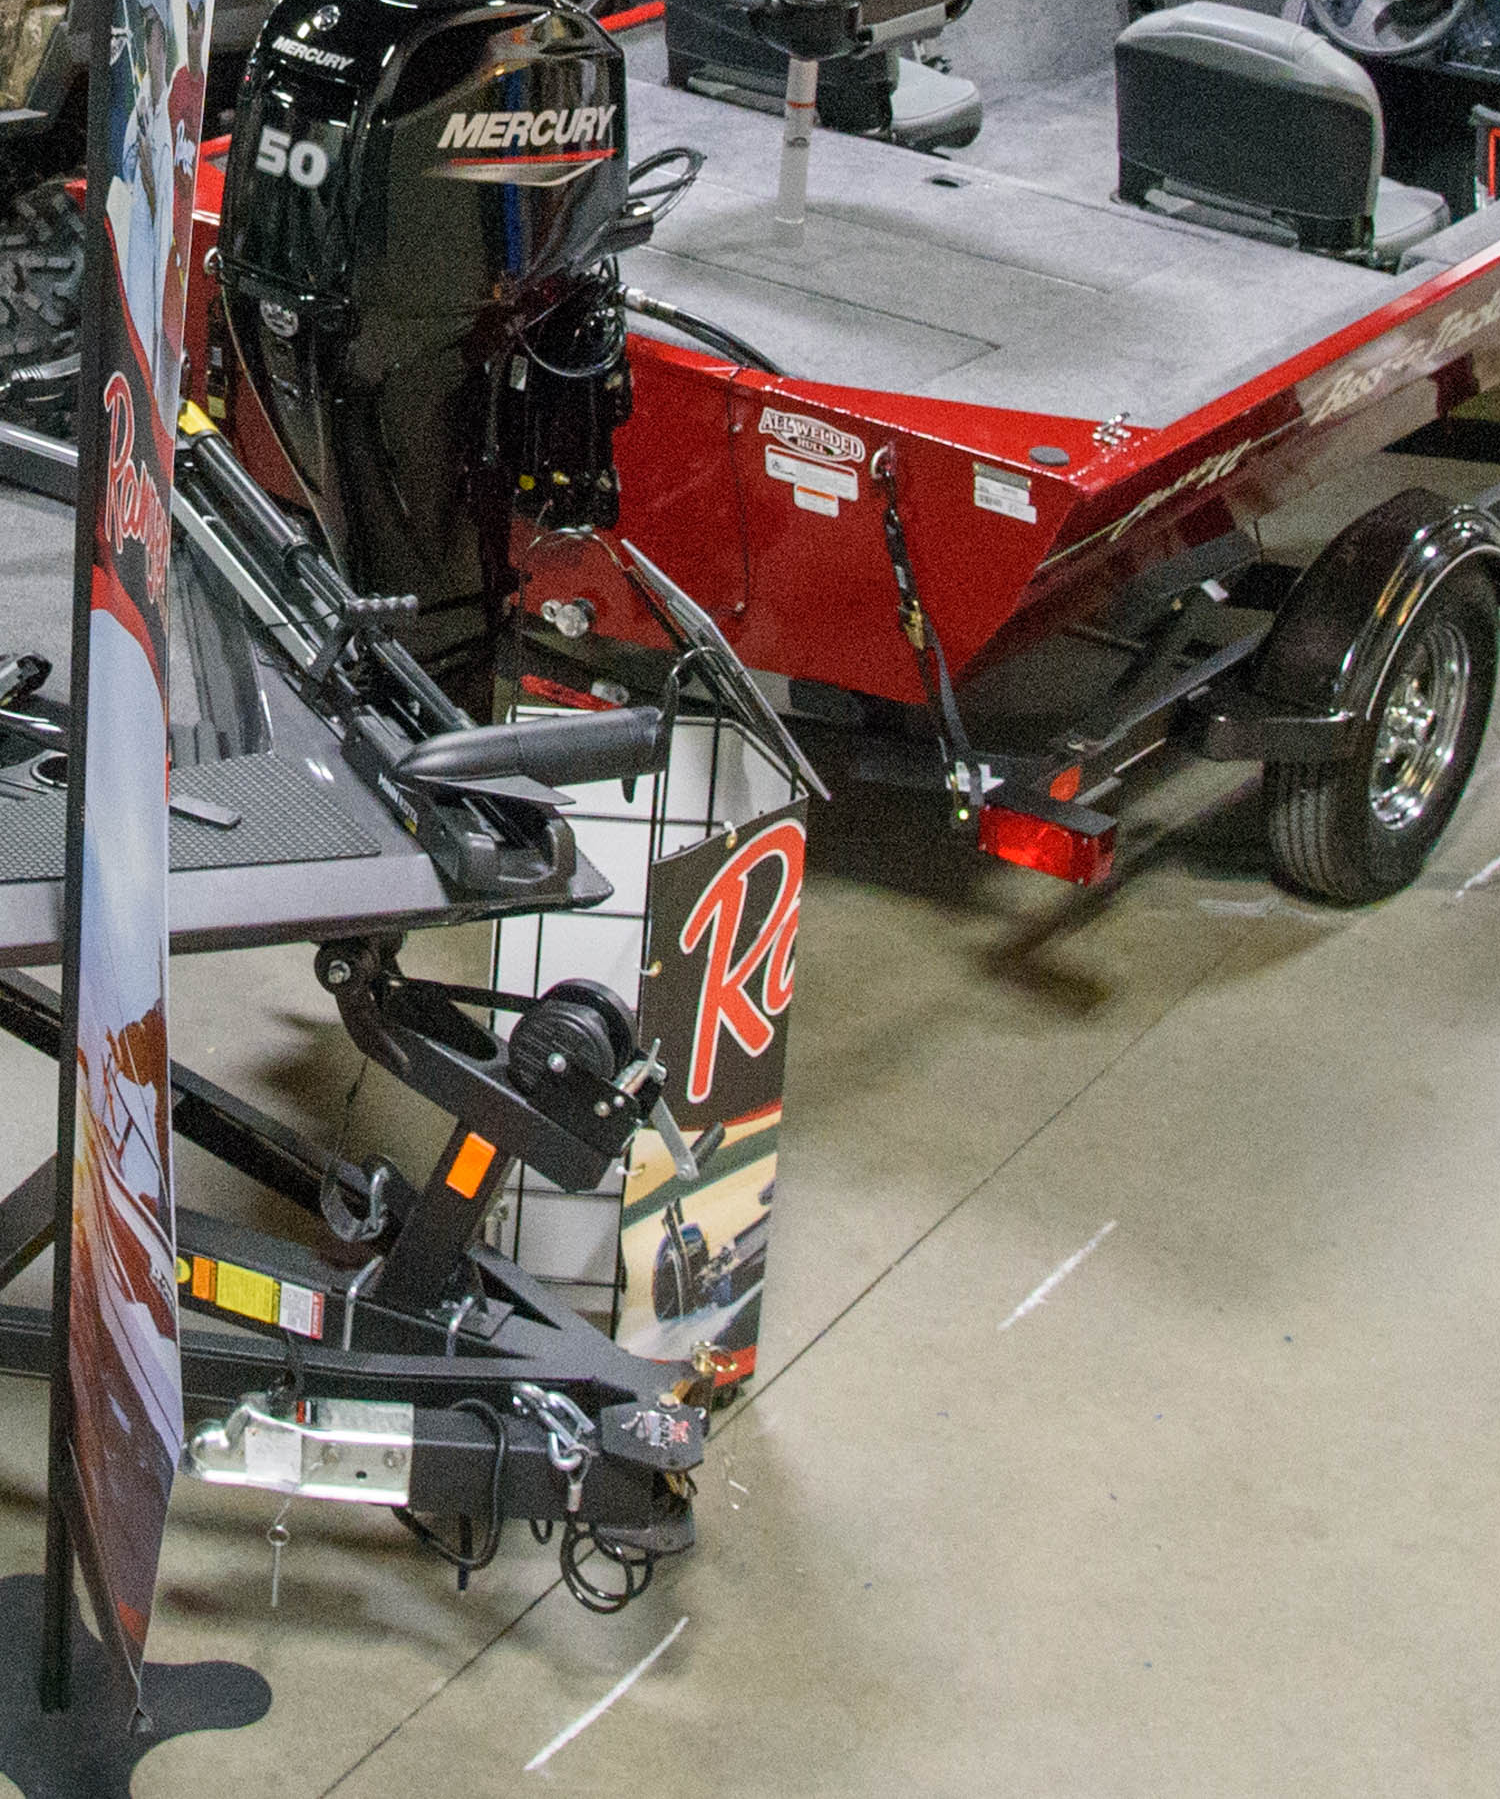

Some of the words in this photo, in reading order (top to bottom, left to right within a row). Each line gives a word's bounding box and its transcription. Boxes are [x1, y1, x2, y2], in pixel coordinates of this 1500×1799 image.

[272, 35, 354, 72] MERCURY
[437, 104, 617, 149] MERCURY
[255, 125, 328, 188] 50
[761, 412, 794, 435] ALL
[792, 422, 861, 457] WELDED
[796, 439, 825, 454] HULL
